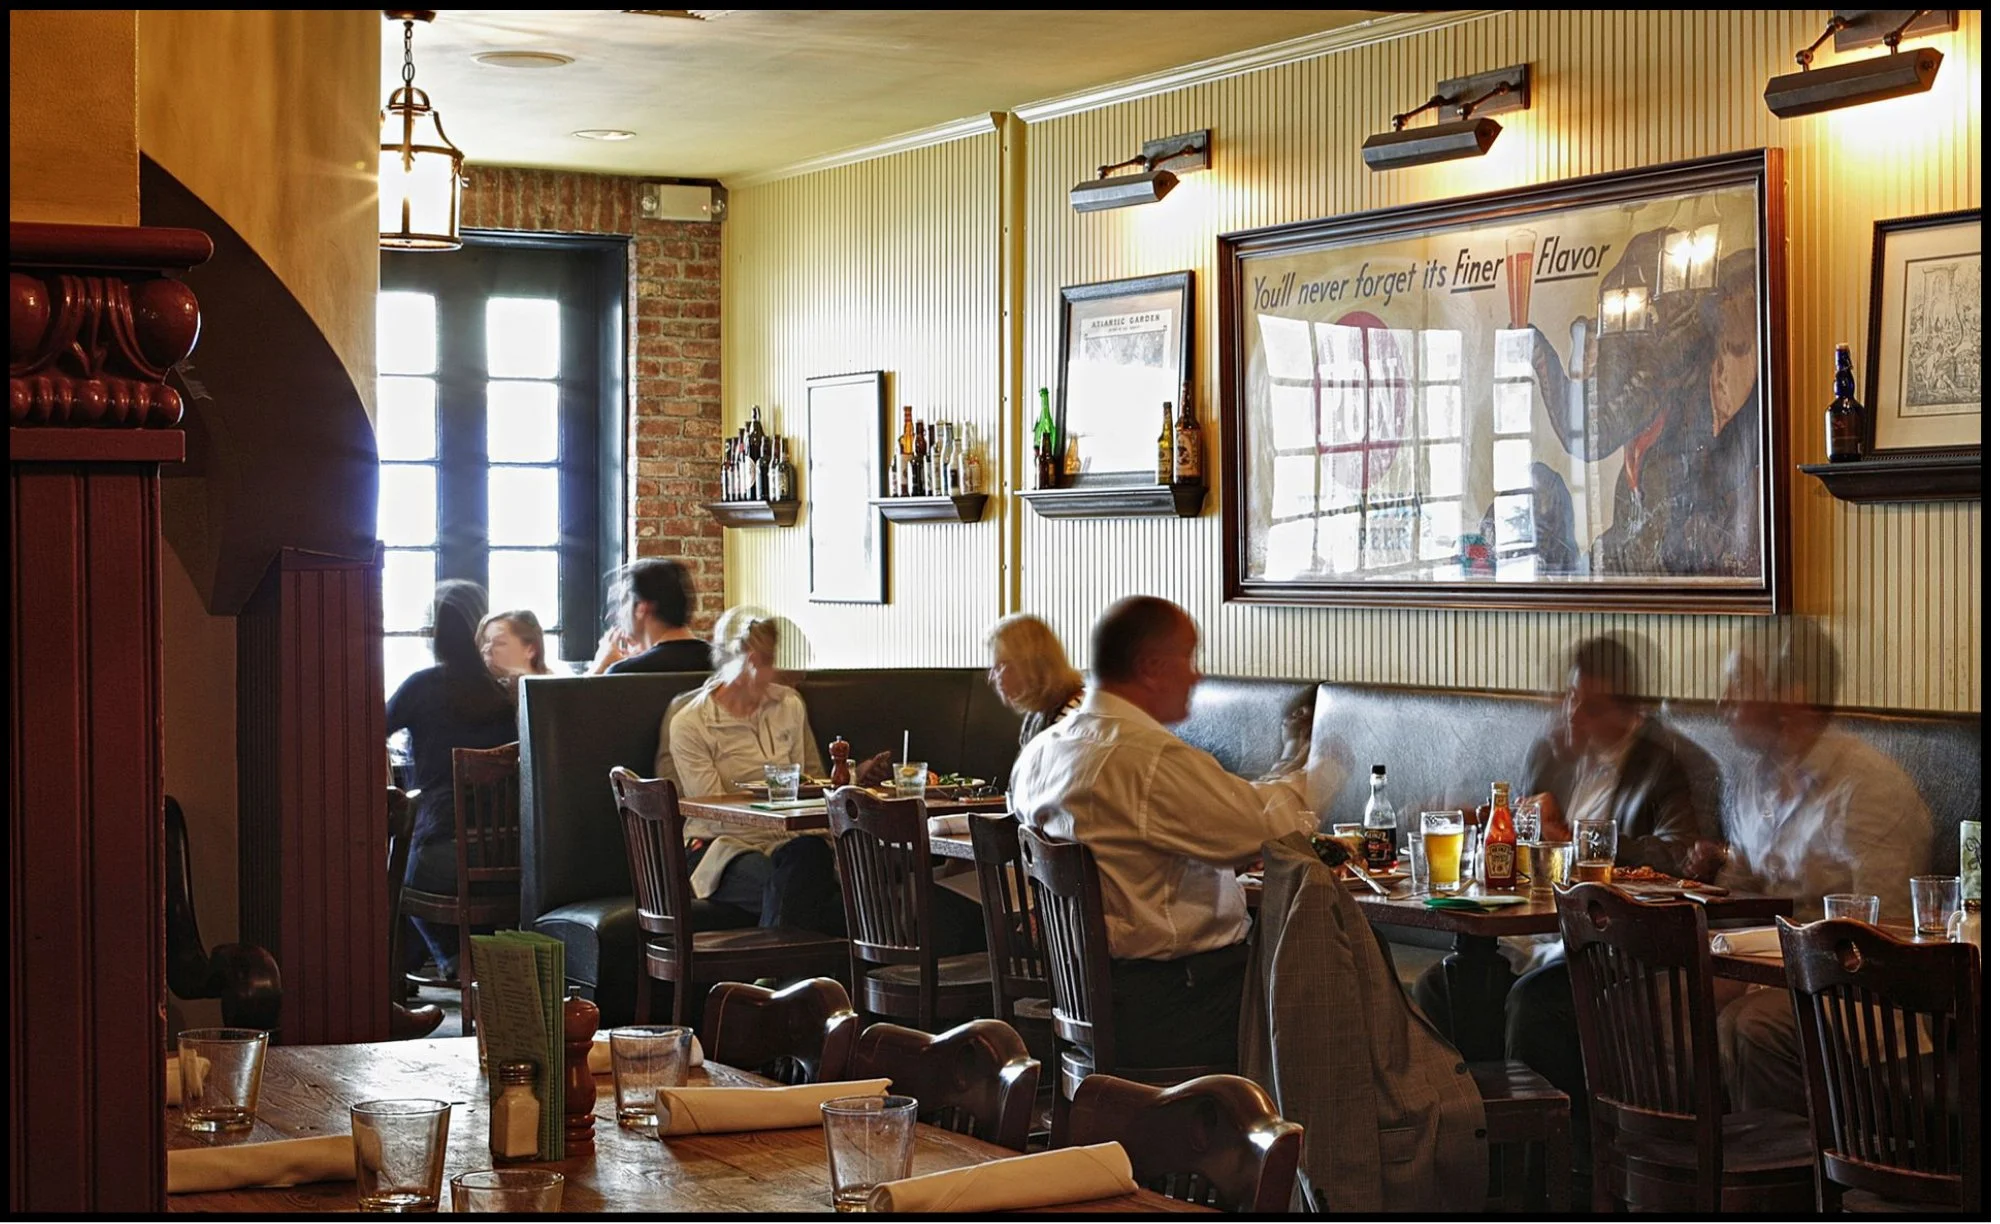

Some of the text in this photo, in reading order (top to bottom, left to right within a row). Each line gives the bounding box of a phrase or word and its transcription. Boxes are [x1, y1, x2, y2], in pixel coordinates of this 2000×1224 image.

[1253, 235, 1612, 310] You'll never forget its Finer Flavor
[1091, 314, 1160, 328] ATLANTIC GARDEN
